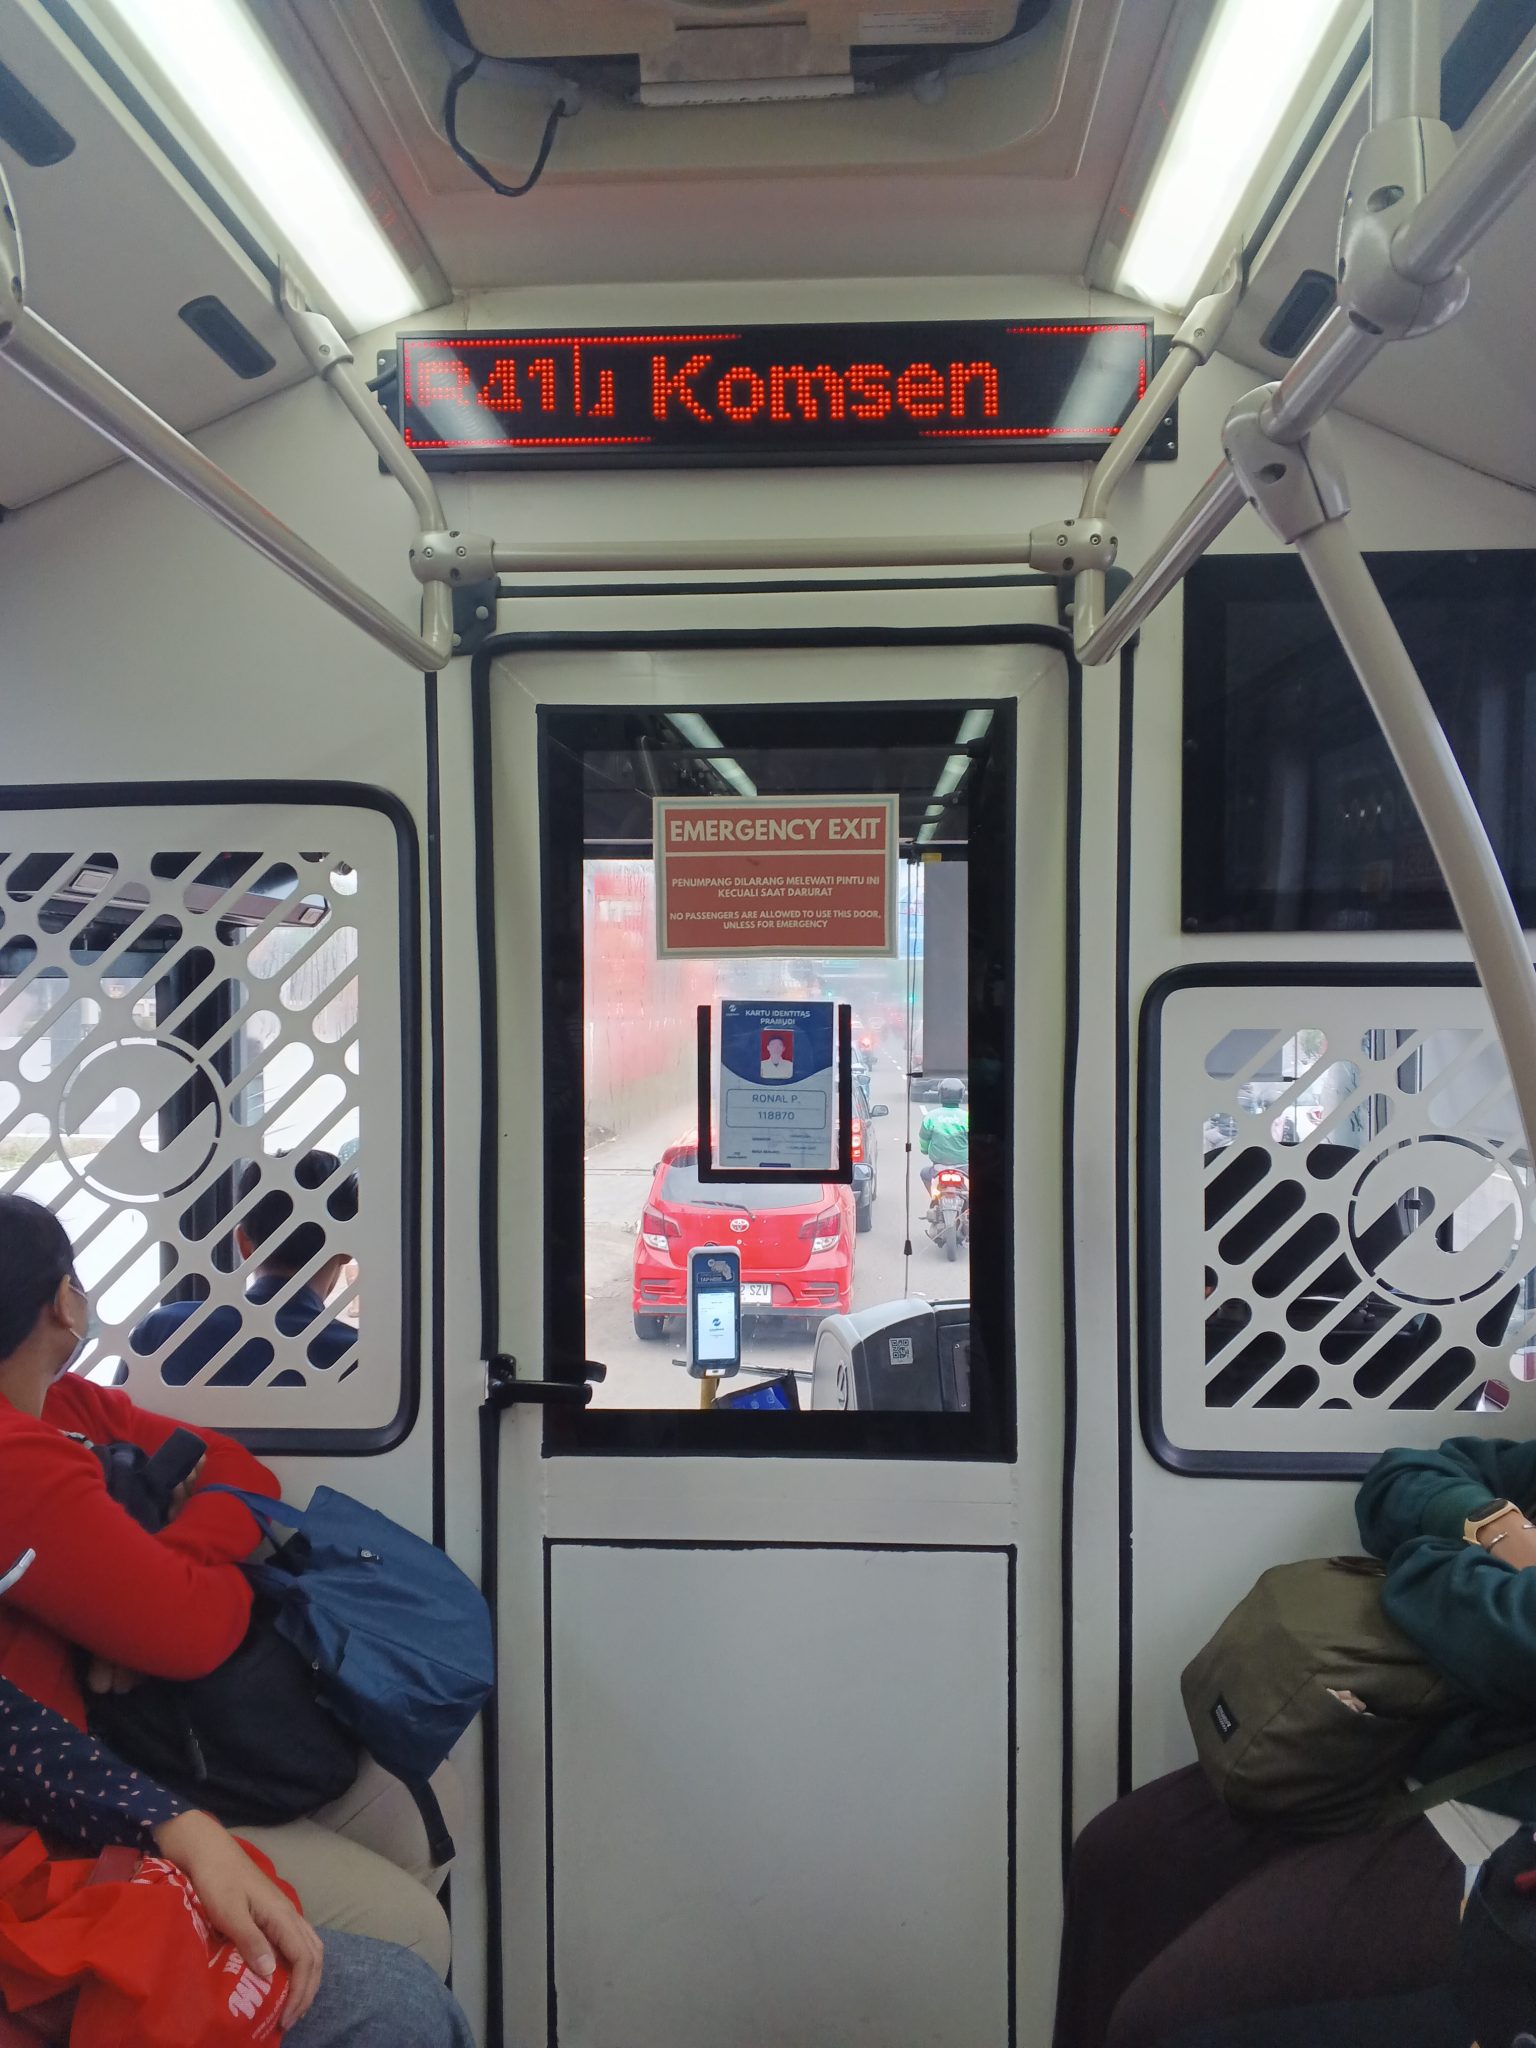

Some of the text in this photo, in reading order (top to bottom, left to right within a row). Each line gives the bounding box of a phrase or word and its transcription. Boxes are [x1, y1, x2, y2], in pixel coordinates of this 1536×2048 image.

[652, 355, 999, 423] Komsen
[670, 817, 881, 842] EMERGENCY EXIT
[671, 876, 880, 888] PENUMPANG DILARANG MELEWATI PINTU INI
[718, 887, 833, 898] KECUALI SAAT DARURAT
[669, 912, 684, 921] NO
[685, 911, 739, 920] PASSENGERS
[741, 911, 758, 919] ARE
[759, 910, 801, 919] ALLOWED
[802, 910, 814, 918] TO
[815, 910, 832, 918] USE
[833, 910, 852, 918] THIS
[723, 920, 828, 930] UNLESS FOR EMERGENCY
[745, 1009, 771, 1018] KARTU
[772, 1010, 811, 1018] IDENTITAS
[752, 1094, 788, 1104] RONAL
[758, 1111, 795, 1121] 118870
